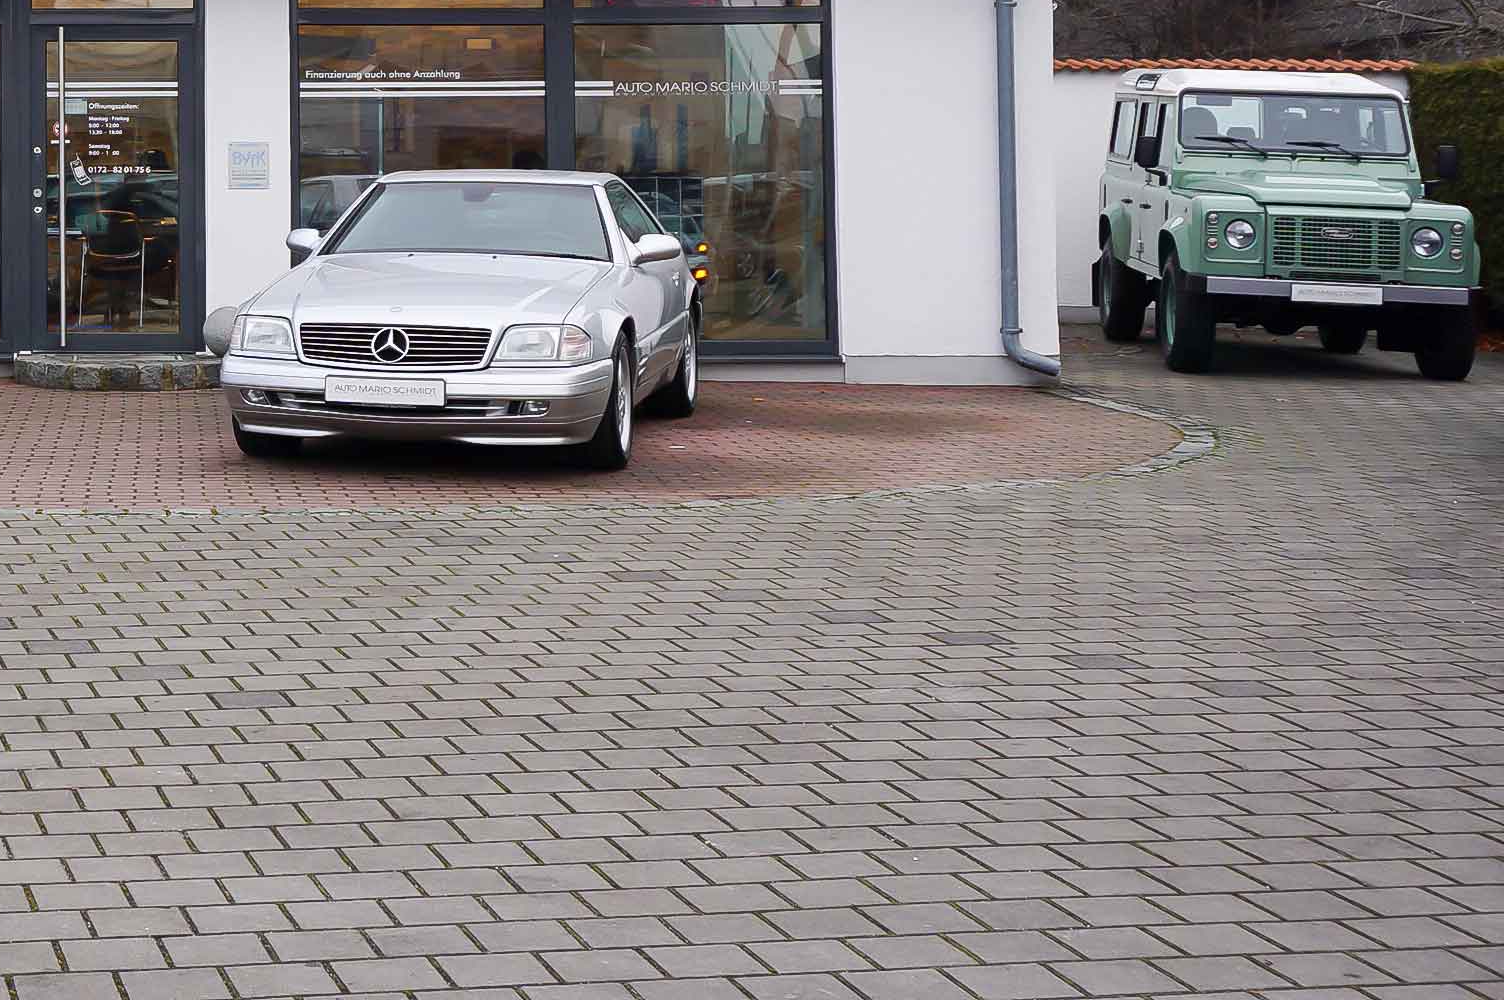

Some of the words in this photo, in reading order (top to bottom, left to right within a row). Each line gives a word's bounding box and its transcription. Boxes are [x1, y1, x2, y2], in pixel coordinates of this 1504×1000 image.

[305, 69, 363, 81] Finanzierung
[365, 70, 386, 79] auch
[389, 70, 411, 79] ohne
[413, 70, 461, 80] Anzahlung
[615, 81, 653, 94] AUTO
[655, 81, 708, 93] MARIO
[710, 80, 778, 93] SCHMIDT
[88, 166, 107, 174] 0172
[335, 384, 357, 392] AUTO
[358, 385, 392, 393] MARIO
[393, 386, 437, 394] SCHMIDT
